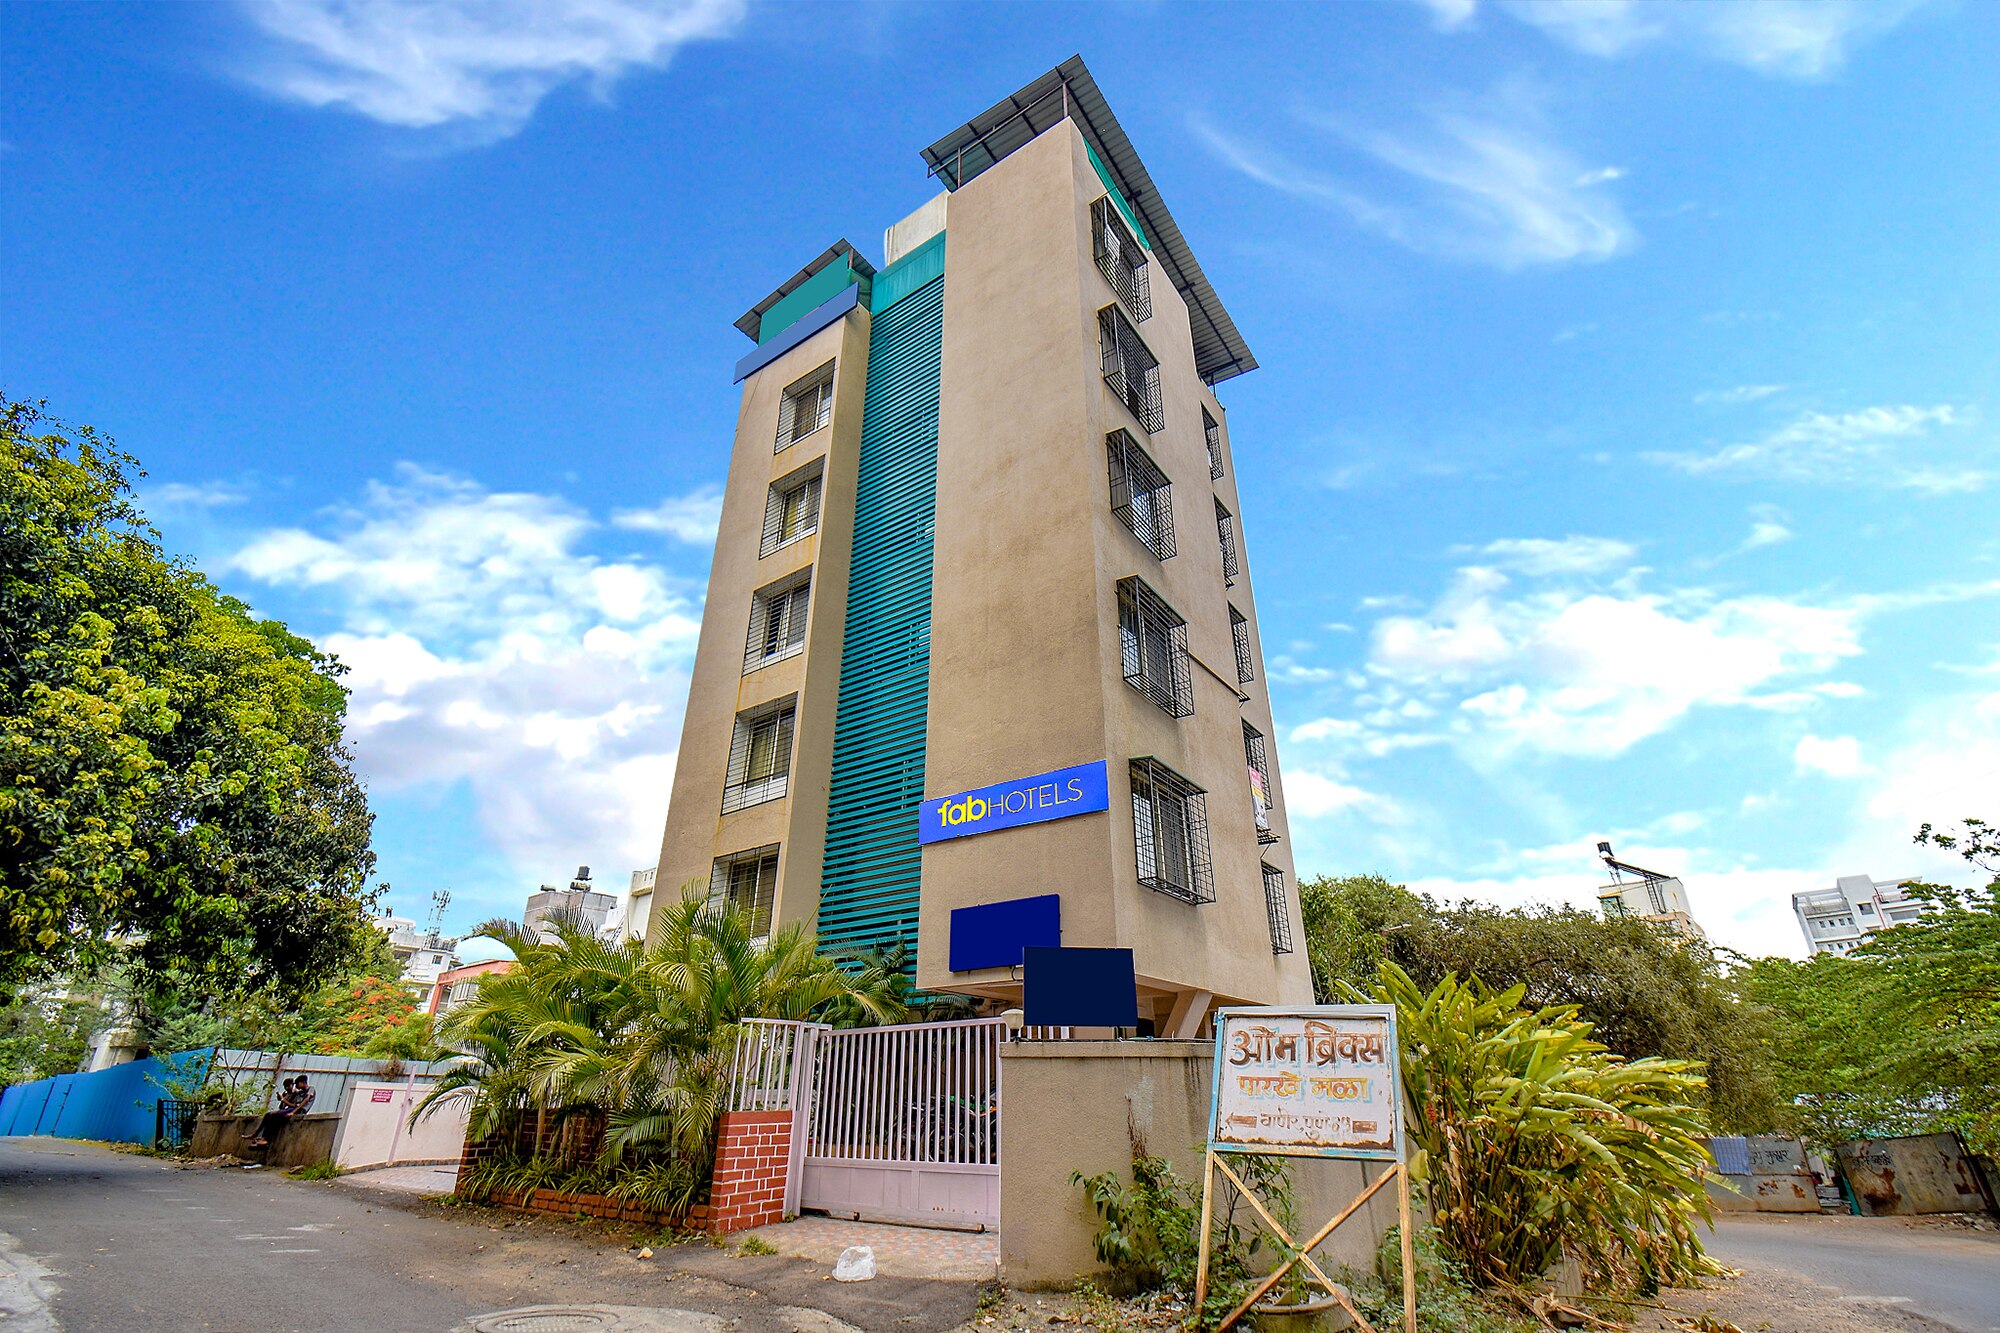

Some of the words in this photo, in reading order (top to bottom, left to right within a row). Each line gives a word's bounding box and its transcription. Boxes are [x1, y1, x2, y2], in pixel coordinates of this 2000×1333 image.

[936, 778, 1083, 827] fabHOTELS
[1304, 1020, 1387, 1066] ब्रिक्स
[1309, 1077, 1370, 1100] मळा
